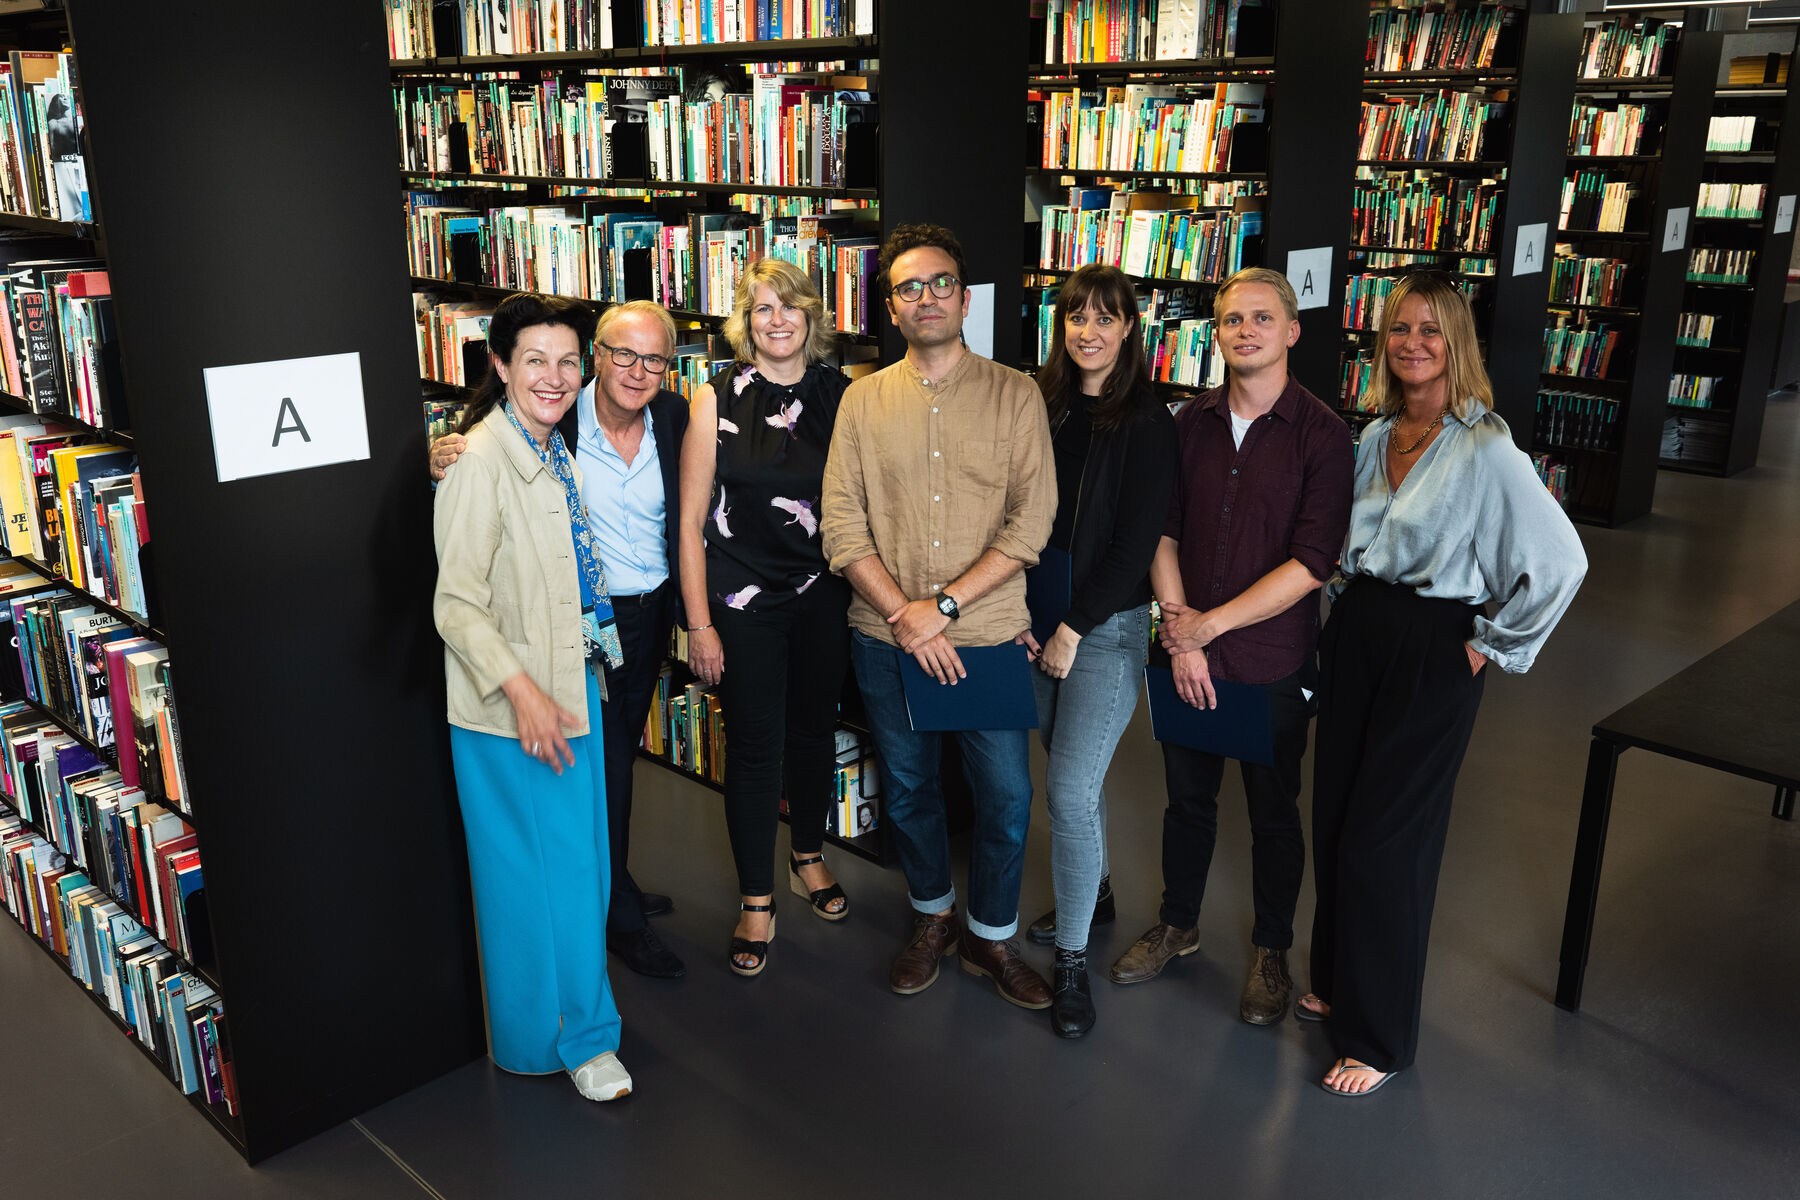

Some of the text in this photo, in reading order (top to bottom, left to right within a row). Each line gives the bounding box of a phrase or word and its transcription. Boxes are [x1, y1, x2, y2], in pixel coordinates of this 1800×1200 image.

[610, 79, 676, 91] JOHNNY DEPP
[605, 135, 613, 175] JOHNNY
[1671, 222, 1679, 241] A
[1524, 241, 1533, 263] A
[1301, 269, 1313, 296] A
[271, 397, 312, 447] A
[89, 616, 114, 627] BURT
